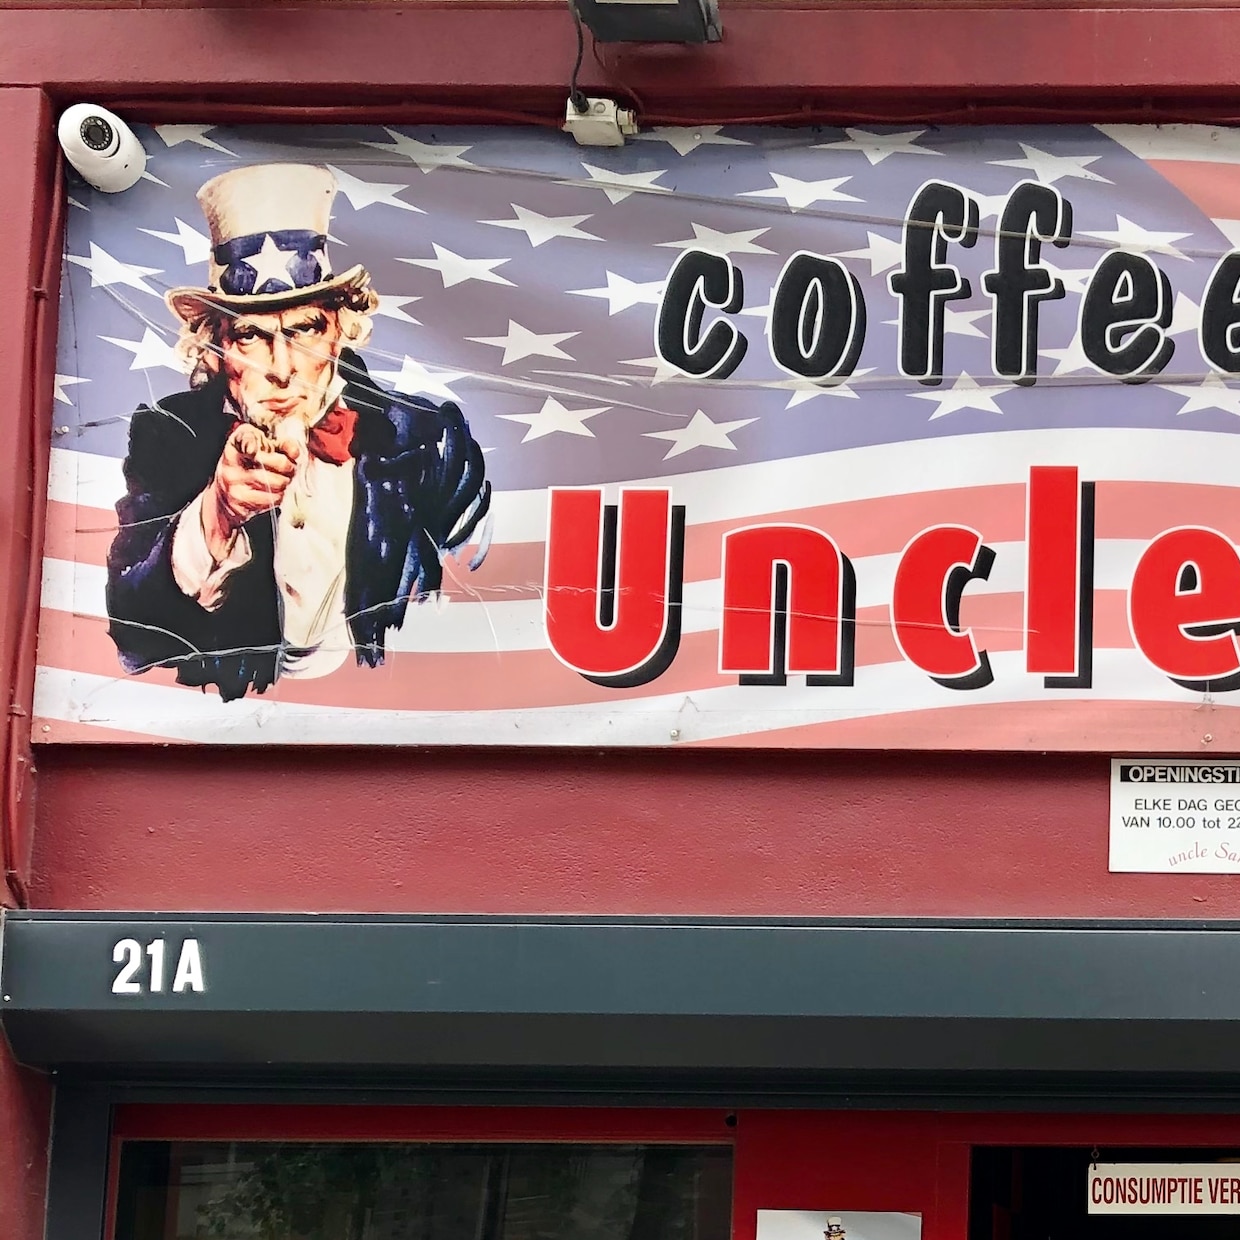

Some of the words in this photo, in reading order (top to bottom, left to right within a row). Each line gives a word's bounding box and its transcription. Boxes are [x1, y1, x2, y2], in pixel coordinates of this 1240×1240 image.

[1134, 798, 1171, 811] ELKE
[1178, 799, 1208, 811] DAG
[1122, 816, 1150, 829] VAN
[1157, 816, 1196, 829] 10.00
[1202, 817, 1221, 829] tot
[1168, 842, 1208, 867] uncle
[1091, 1177, 1203, 1205] CONSUMPTIE
